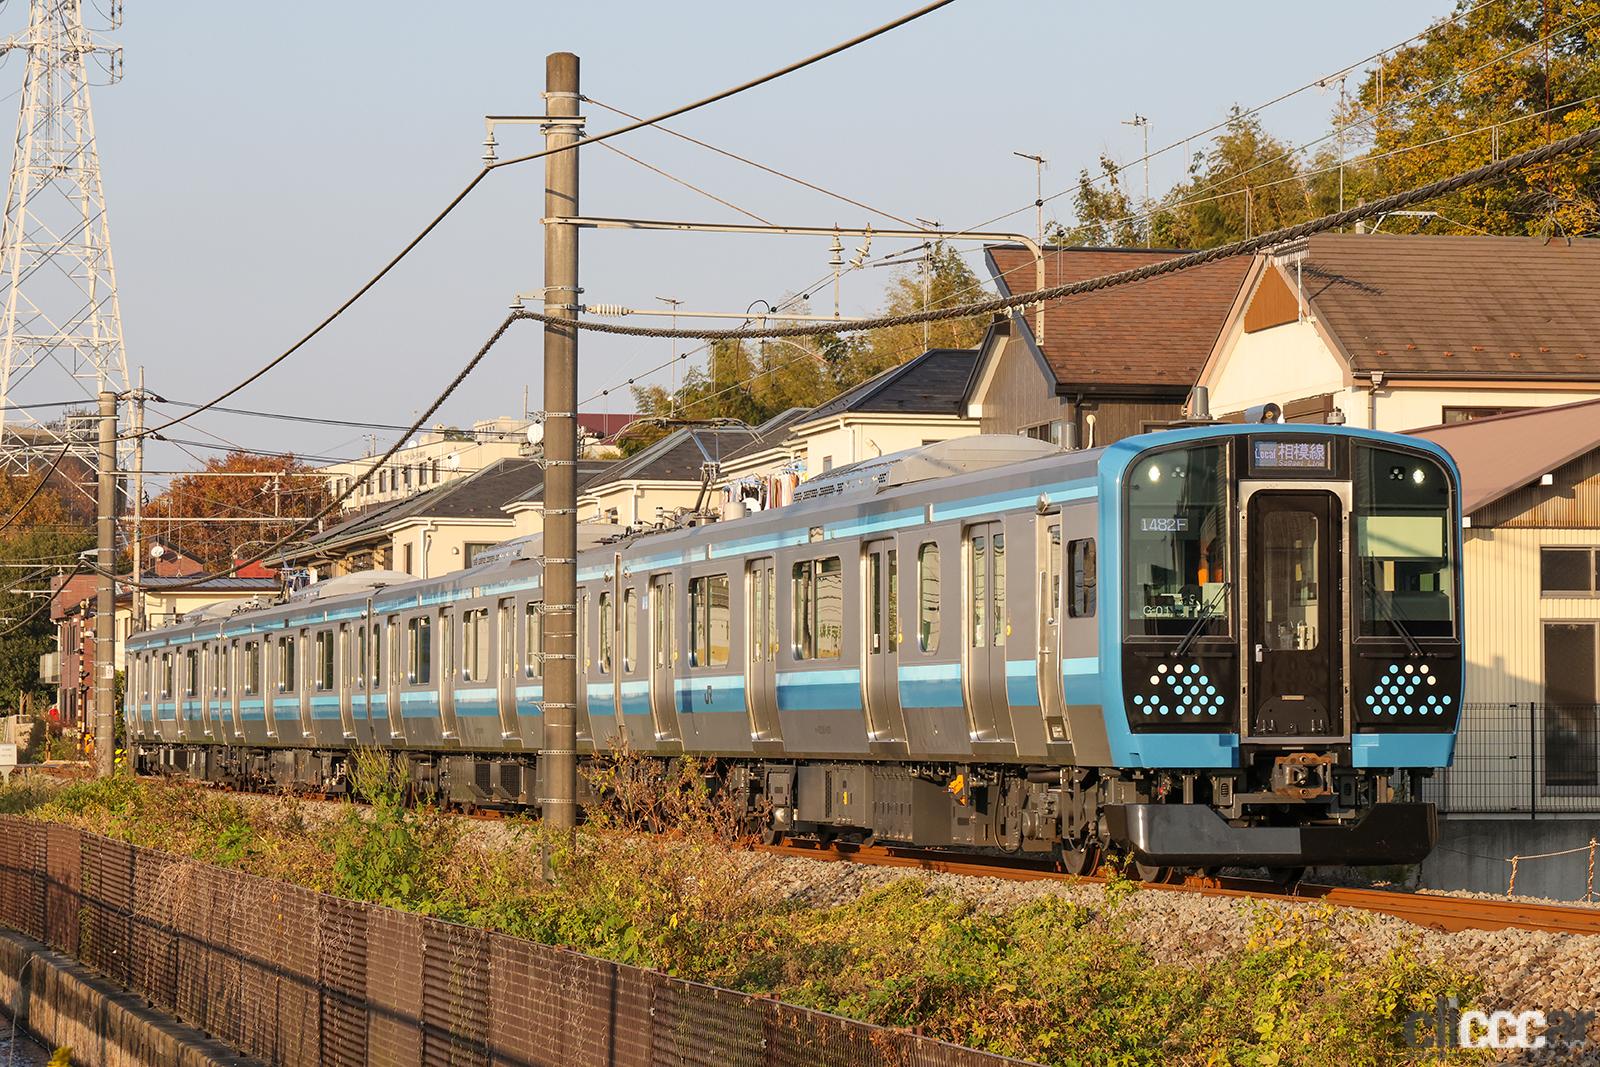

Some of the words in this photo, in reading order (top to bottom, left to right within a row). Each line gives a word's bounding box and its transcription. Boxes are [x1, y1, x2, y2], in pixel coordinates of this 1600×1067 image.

[1255, 447, 1277, 460] Local
[1278, 443, 1325, 460] 相模線
[1141, 518, 1188, 532] 1482F
